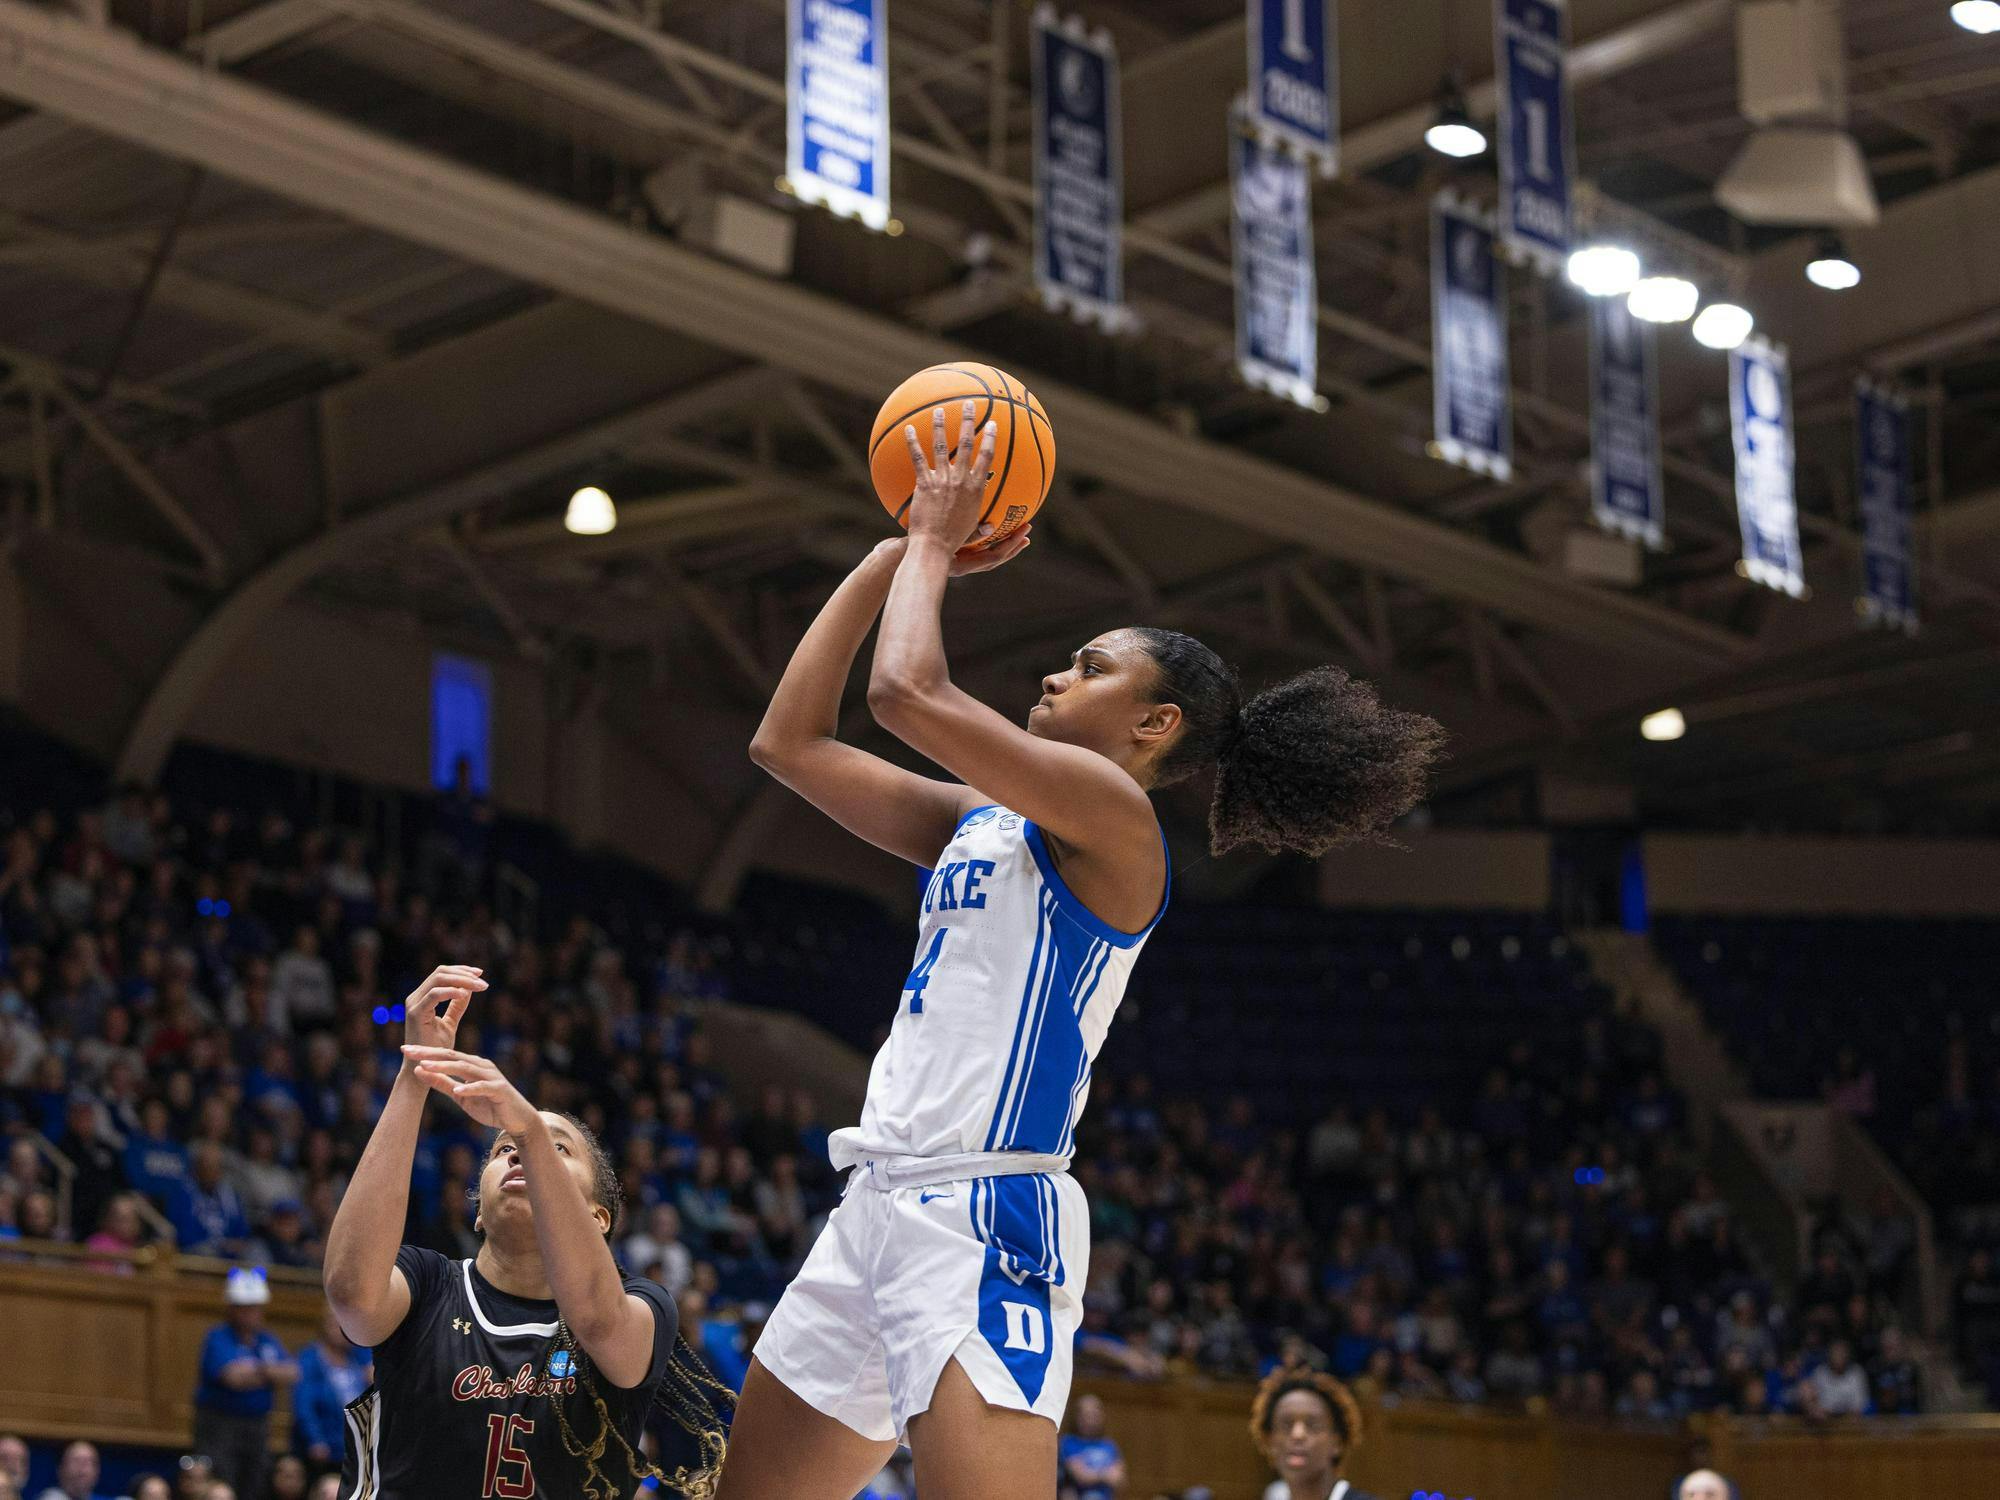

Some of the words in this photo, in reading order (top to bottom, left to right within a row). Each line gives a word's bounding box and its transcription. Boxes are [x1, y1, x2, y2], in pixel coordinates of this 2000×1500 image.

[925, 859, 997, 914] UKE
[904, 927, 948, 1014] 4
[1001, 1301, 1046, 1355] D
[482, 1413, 535, 1500] 15
